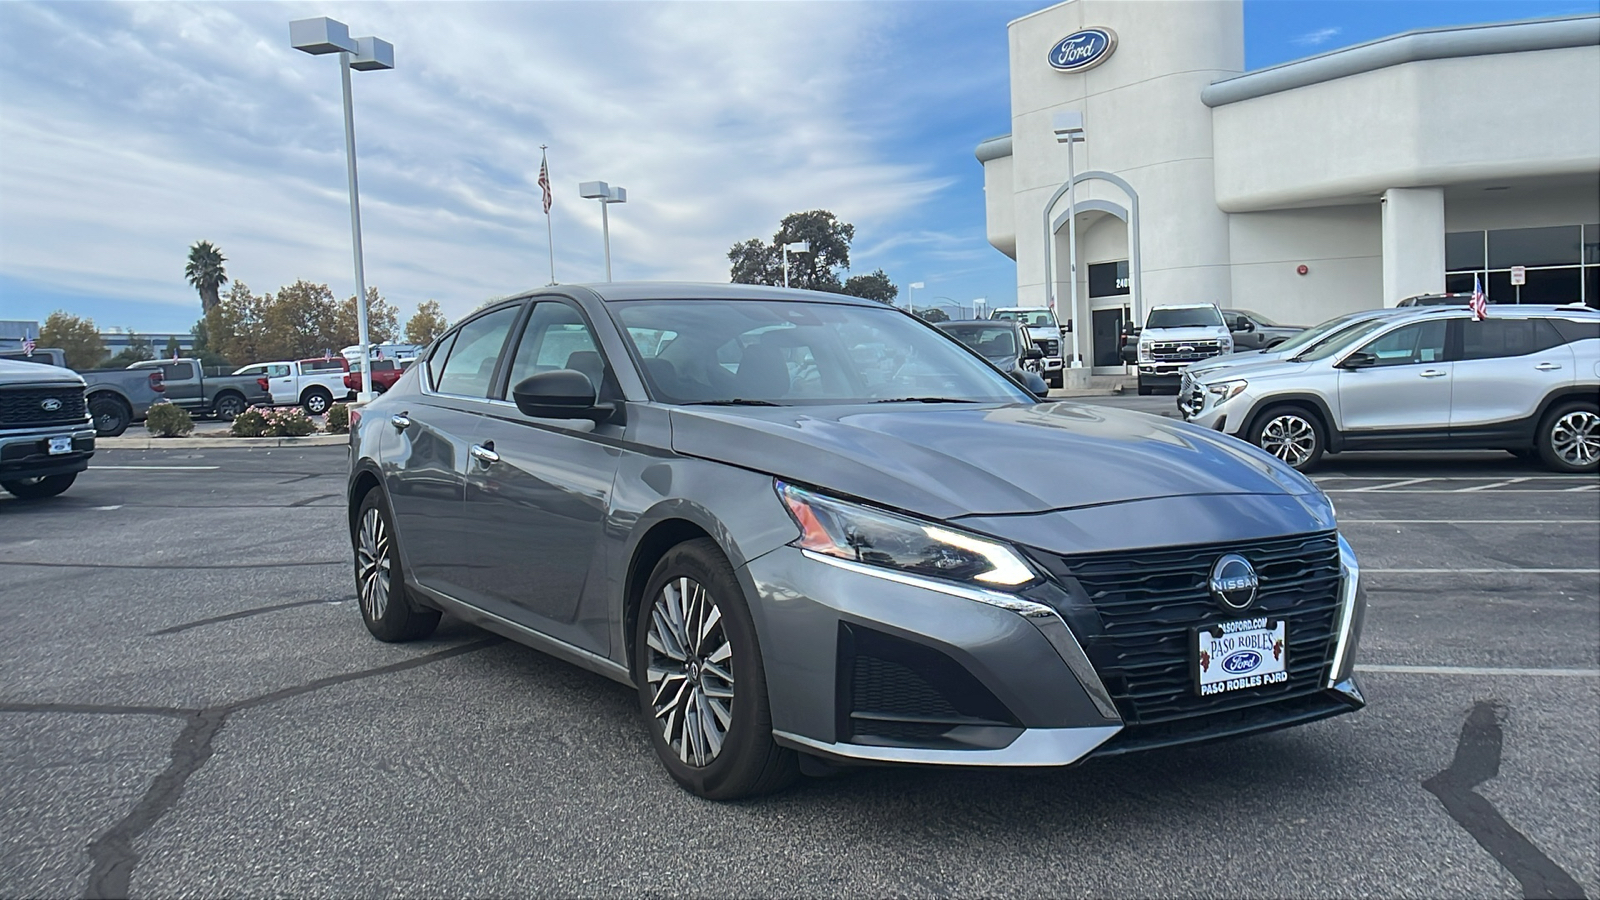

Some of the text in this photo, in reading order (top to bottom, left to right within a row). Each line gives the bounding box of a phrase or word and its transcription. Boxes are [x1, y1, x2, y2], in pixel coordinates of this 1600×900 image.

[1058, 36, 1095, 64] Ford
[1212, 576, 1258, 591] NISSAN
[1210, 632, 1274, 660] PASO ROBLES
[1230, 654, 1255, 671] Ford
[1201, 671, 1288, 696] PASO ROBLES FORD
